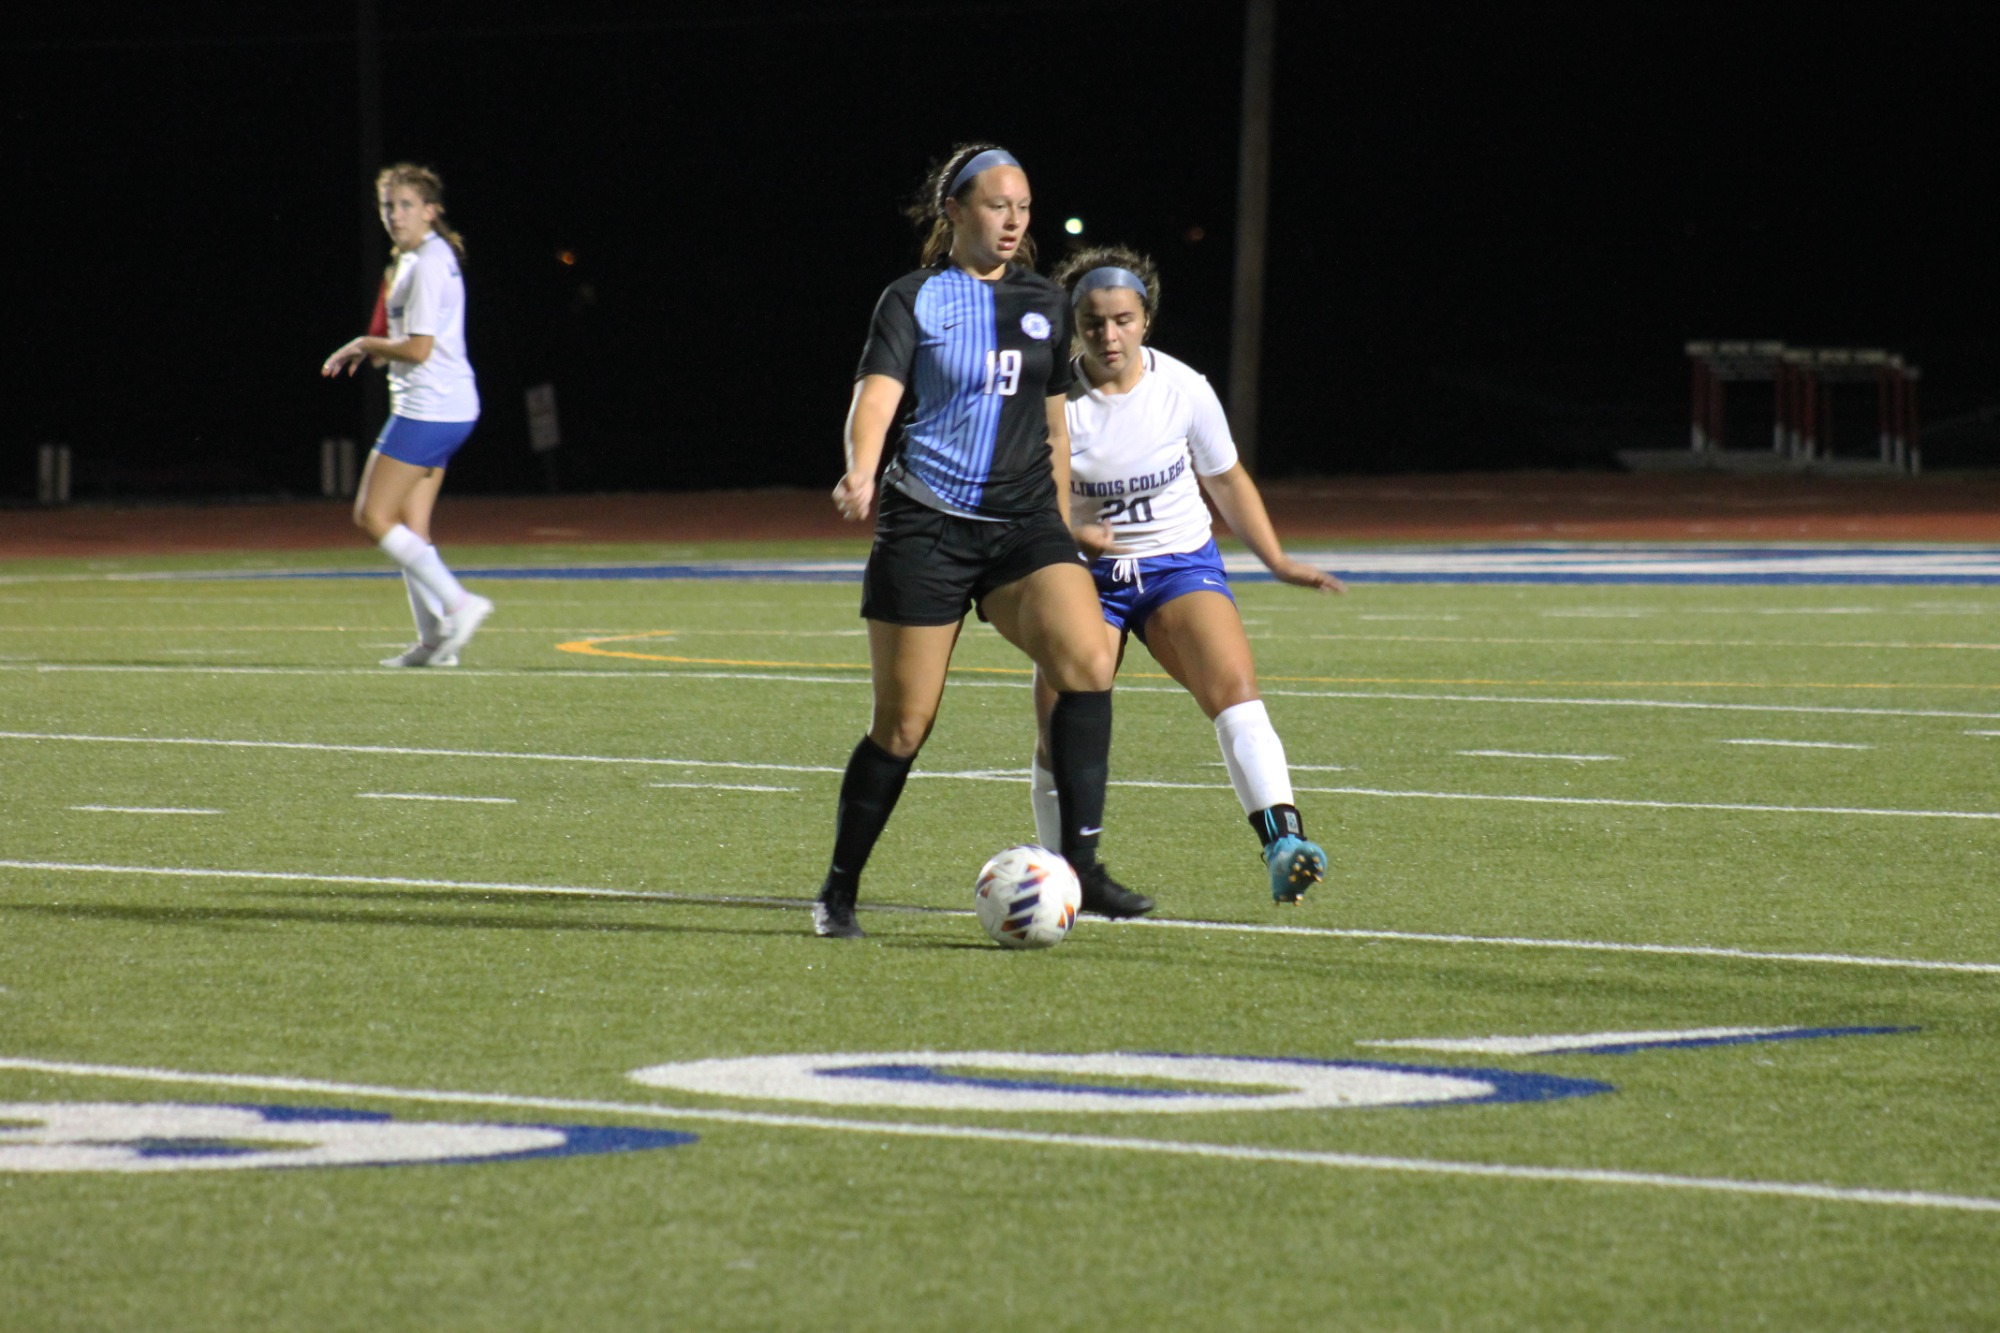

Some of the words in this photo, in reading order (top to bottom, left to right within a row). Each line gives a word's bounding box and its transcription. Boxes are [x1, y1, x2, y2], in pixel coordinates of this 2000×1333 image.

[983, 350, 1022, 396] 19
[1129, 455, 1185, 492] COLLEGE
[1100, 496, 1155, 525] 20
